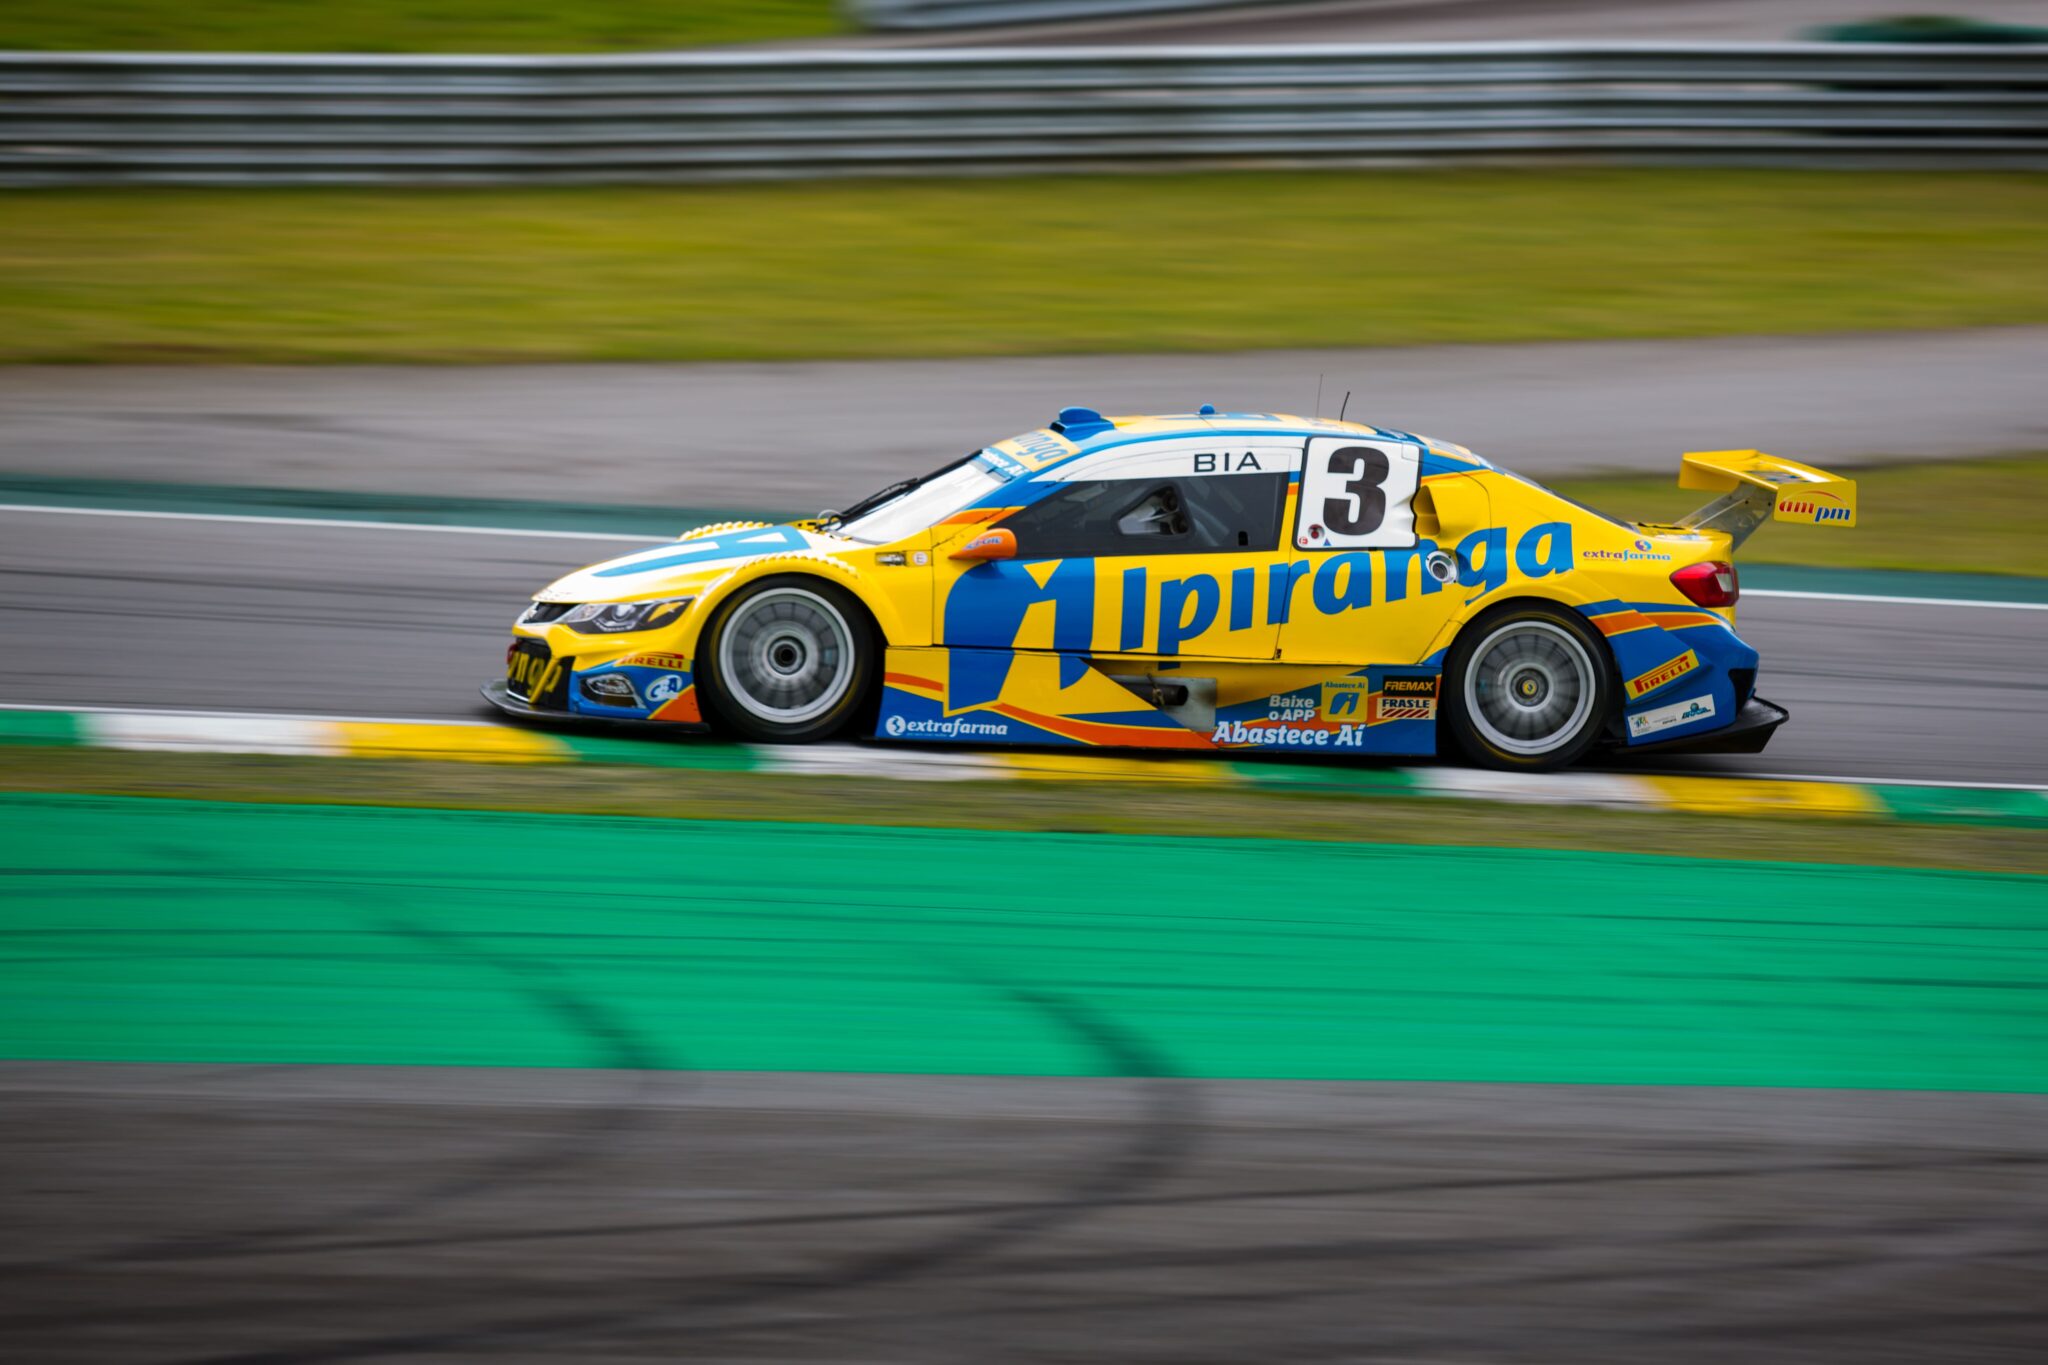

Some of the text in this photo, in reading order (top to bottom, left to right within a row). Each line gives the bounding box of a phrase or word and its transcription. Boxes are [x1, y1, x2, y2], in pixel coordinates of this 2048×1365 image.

[1193, 451, 1262, 473] BIA
[1322, 446, 1390, 536] 3
[1583, 549, 1672, 562] extrafarma
[1119, 522, 1575, 671] Ipiranga
[1633, 655, 1691, 694] PIRELLI
[1384, 681, 1434, 692] FREMAX
[1269, 695, 1315, 709] Baixe
[1269, 709, 1316, 722] o APP
[907, 718, 1008, 738] extrafarma
[1211, 720, 1367, 747] Abastece Aí
